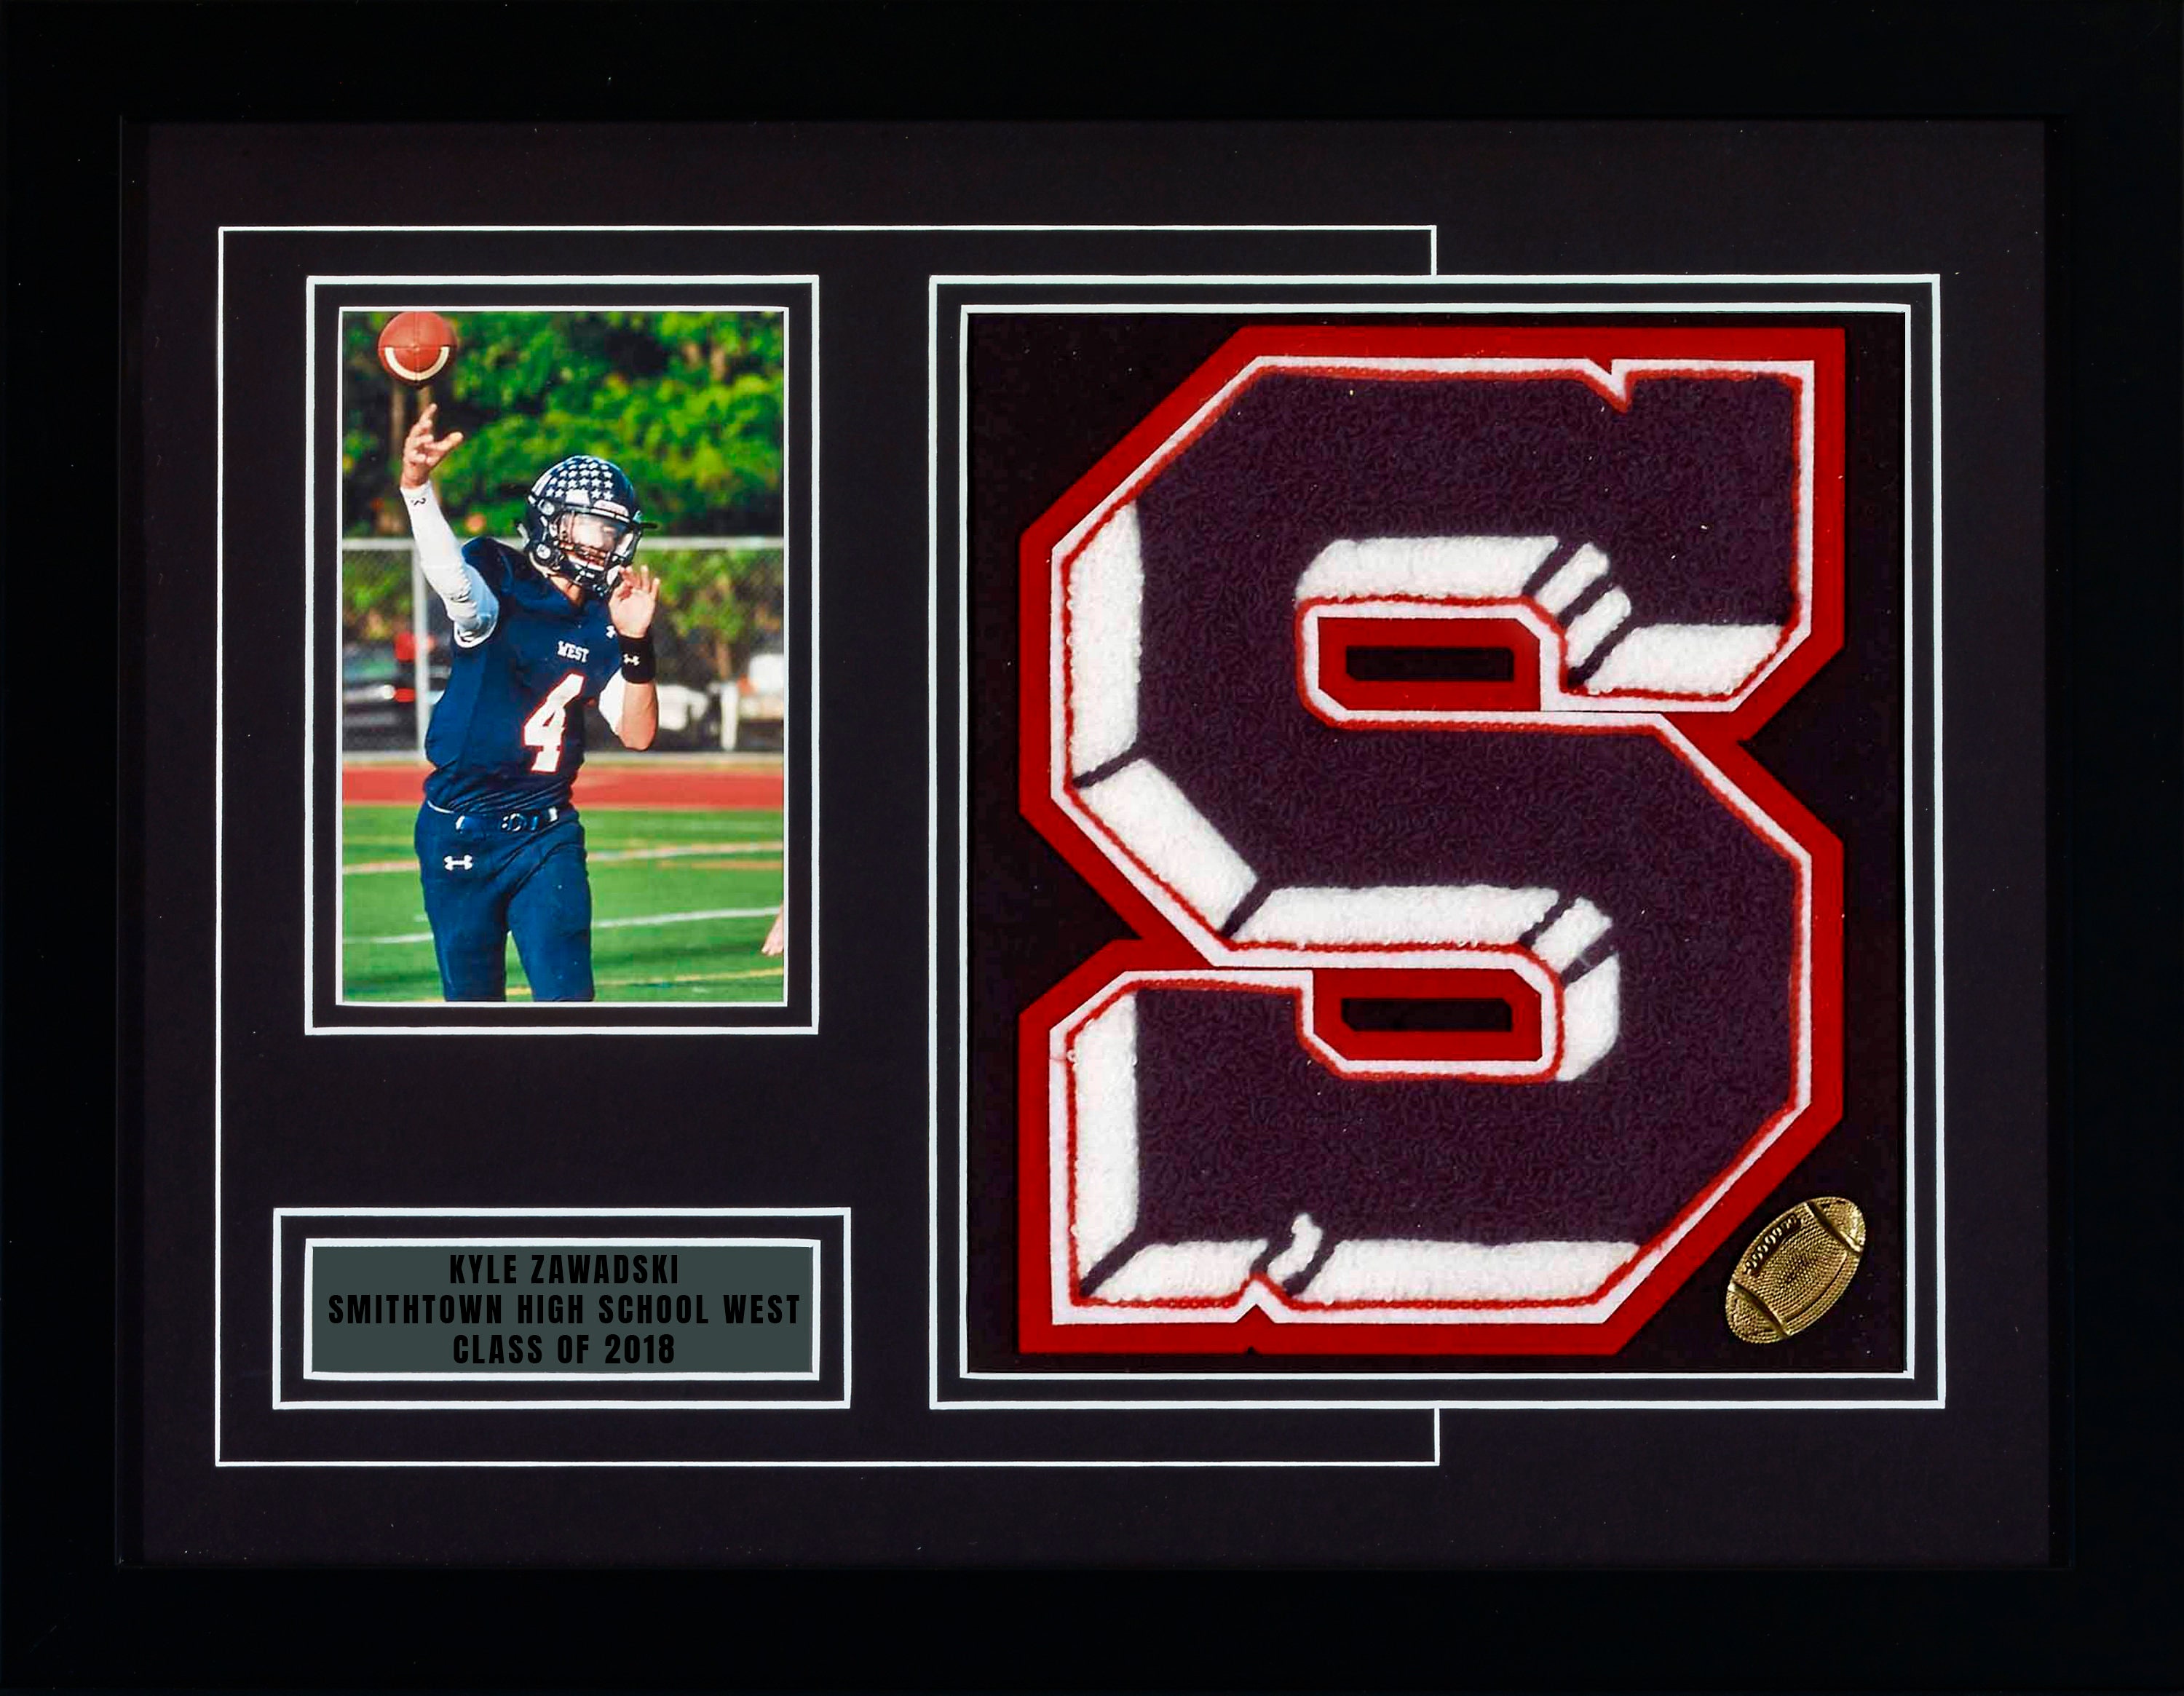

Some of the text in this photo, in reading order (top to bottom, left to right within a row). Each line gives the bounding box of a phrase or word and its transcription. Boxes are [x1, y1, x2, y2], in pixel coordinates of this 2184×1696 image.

[557, 640, 590, 662] WEST
[521, 670, 587, 773] 4
[1019, 326, 1845, 1355] S
[450, 1254, 678, 1284] KYLE ZAWADSKI
[328, 1294, 799, 1324] SMITHTOWN HIGH SCHOOL WEST
[453, 1334, 675, 1364] CLASS OF 2018
